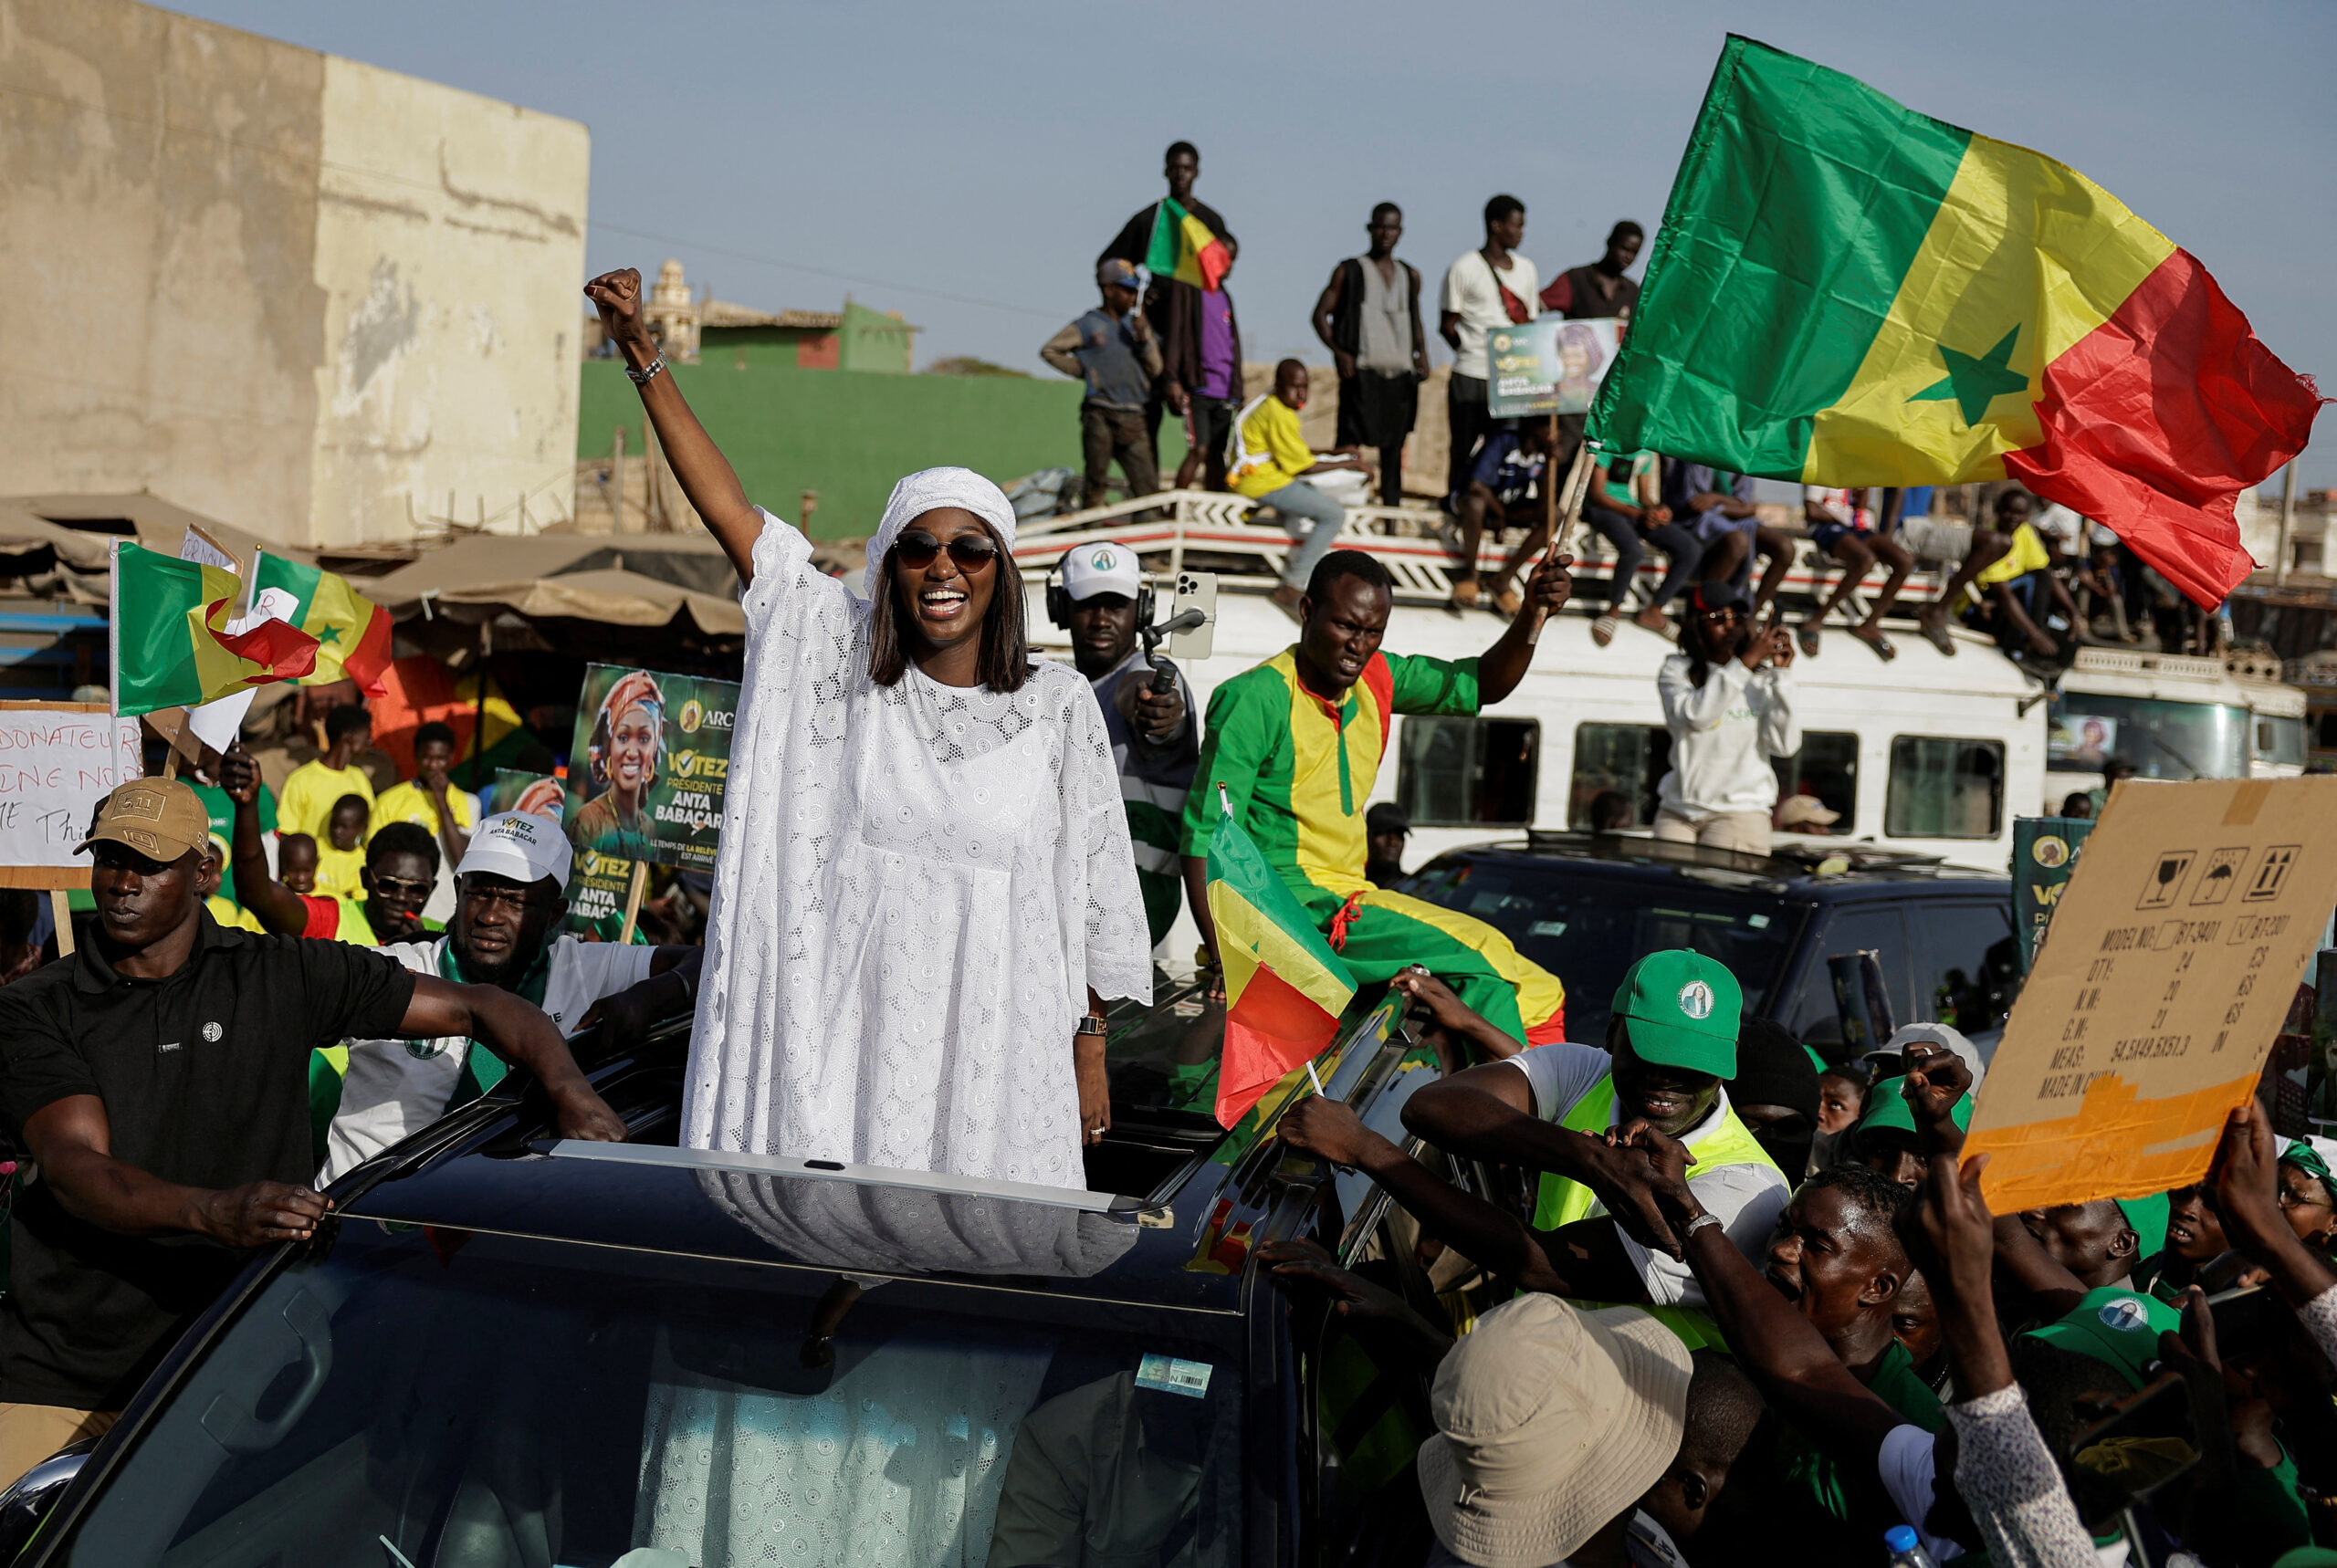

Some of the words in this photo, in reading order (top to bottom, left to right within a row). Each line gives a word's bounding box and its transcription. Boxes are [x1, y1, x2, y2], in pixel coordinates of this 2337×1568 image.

[667, 749, 729, 778] VOTEZ
[672, 791, 711, 810] ANTA
[502, 817, 535, 833] VOTEZ
[655, 805, 722, 829] BABACAR
[505, 829, 537, 846] BABACAR
[573, 850, 631, 877] VOTEZ
[578, 887, 616, 906] ANTA
[2101, 927, 2138, 951] MODEL
[2175, 950, 2195, 972] 24
[2163, 979, 2181, 1000] 20
[2151, 1009, 2168, 1030] 21
[2050, 1045, 2084, 1070] MEAS:
[2038, 1075, 2072, 1100] MADE
